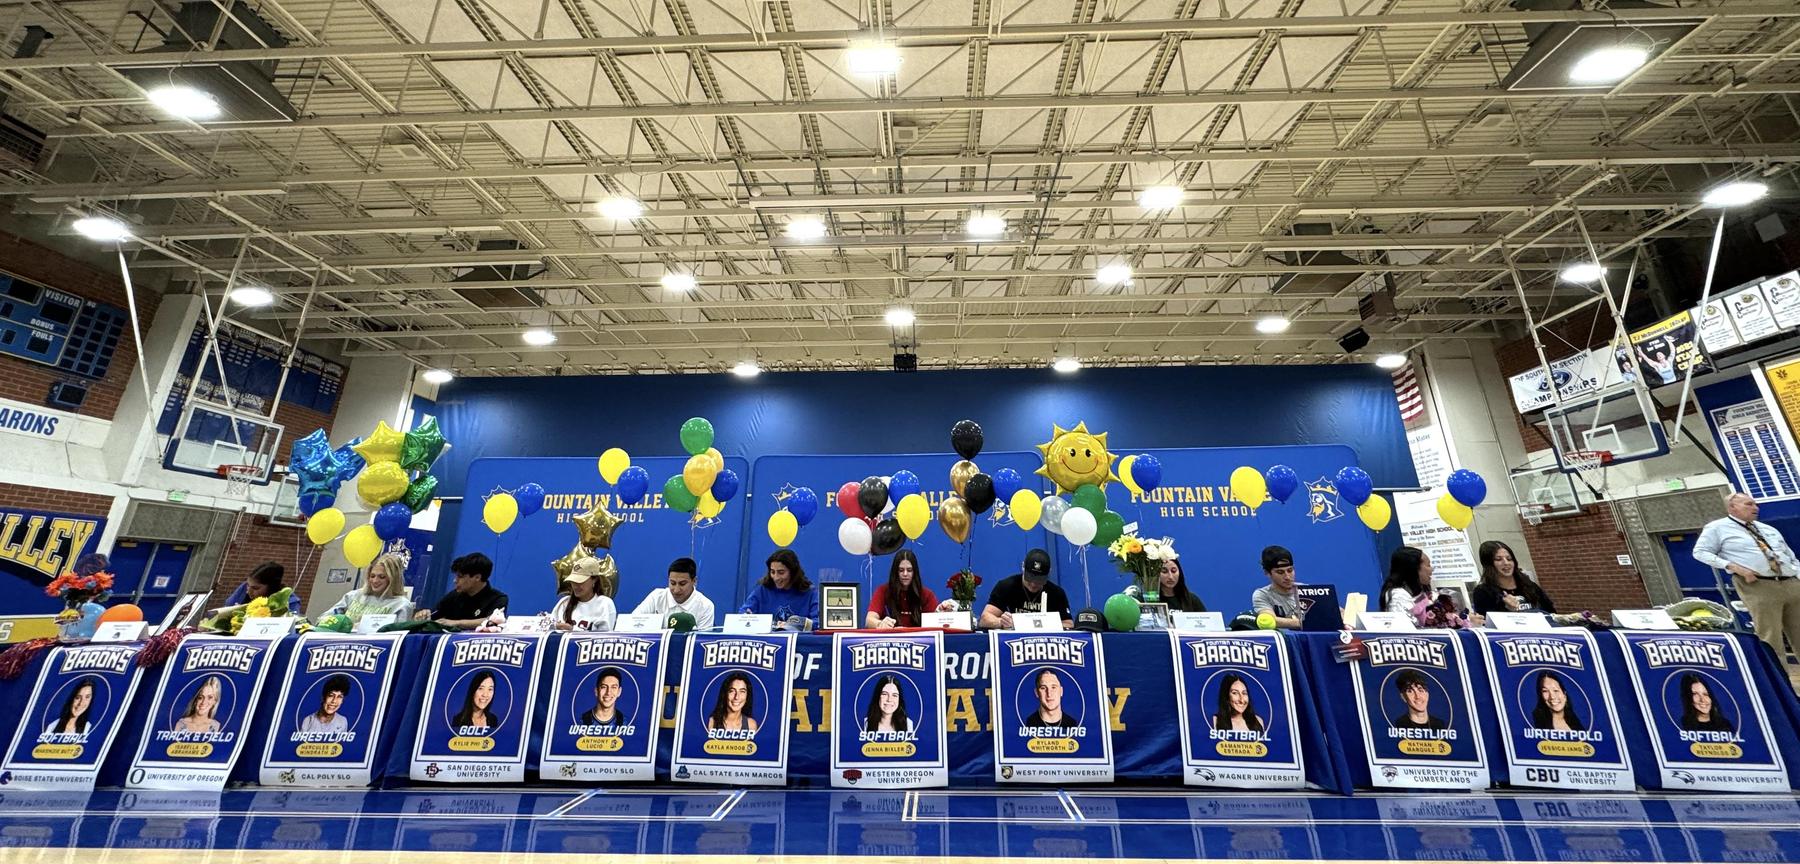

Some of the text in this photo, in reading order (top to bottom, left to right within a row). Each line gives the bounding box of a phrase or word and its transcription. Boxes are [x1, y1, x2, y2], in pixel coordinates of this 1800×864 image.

[45, 289, 81, 308] VISITOR
[30, 318, 54, 330] BONUS
[31, 330, 54, 341] FOULS
[542, 494, 611, 509] OUNTAIN
[1160, 506, 1257, 517] HIGH SCHOOL
[1297, 588, 1330, 597] ATRIOT
[454, 641, 528, 664] BARONS
[578, 641, 652, 664] BARONS
[705, 643, 777, 668] BARONS
[853, 645, 926, 668] BARONS
[1010, 641, 1084, 665] BARONS
[1193, 643, 1268, 668] BARONS
[1367, 641, 1446, 666] BARONS
[1503, 641, 1582, 667] BARONS
[1646, 642, 1724, 667] BARONS
[62, 649, 137, 672] BARONS
[185, 648, 258, 671] BARONS
[309, 648, 381, 671] BARONS
[459, 726, 490, 735] GOLF
[569, 725, 635, 735] WRESTLING
[708, 728, 755, 739] SOCCER
[859, 731, 919, 741] SOFTBALL
[1018, 727, 1087, 737] WRESTLING
[1209, 730, 1271, 741] SOFTBALL
[1388, 728, 1457, 739] WRESTLING
[1524, 728, 1602, 741] WATER POLO
[1680, 730, 1745, 742] SOFTBALL
[37, 732, 89, 743] SOFTBALL
[156, 731, 234, 742] TRACK & FIELD
[290, 731, 356, 742] WRESTLING
[34, 775, 54, 783] STATE
[55, 775, 94, 783] UNIVERSITY
[197, 774, 224, 782] OREGON
[1526, 768, 1560, 782] CBU
[1585, 771, 1617, 779] BAPTIST
[1735, 776, 1783, 784] UNIVERSITY
